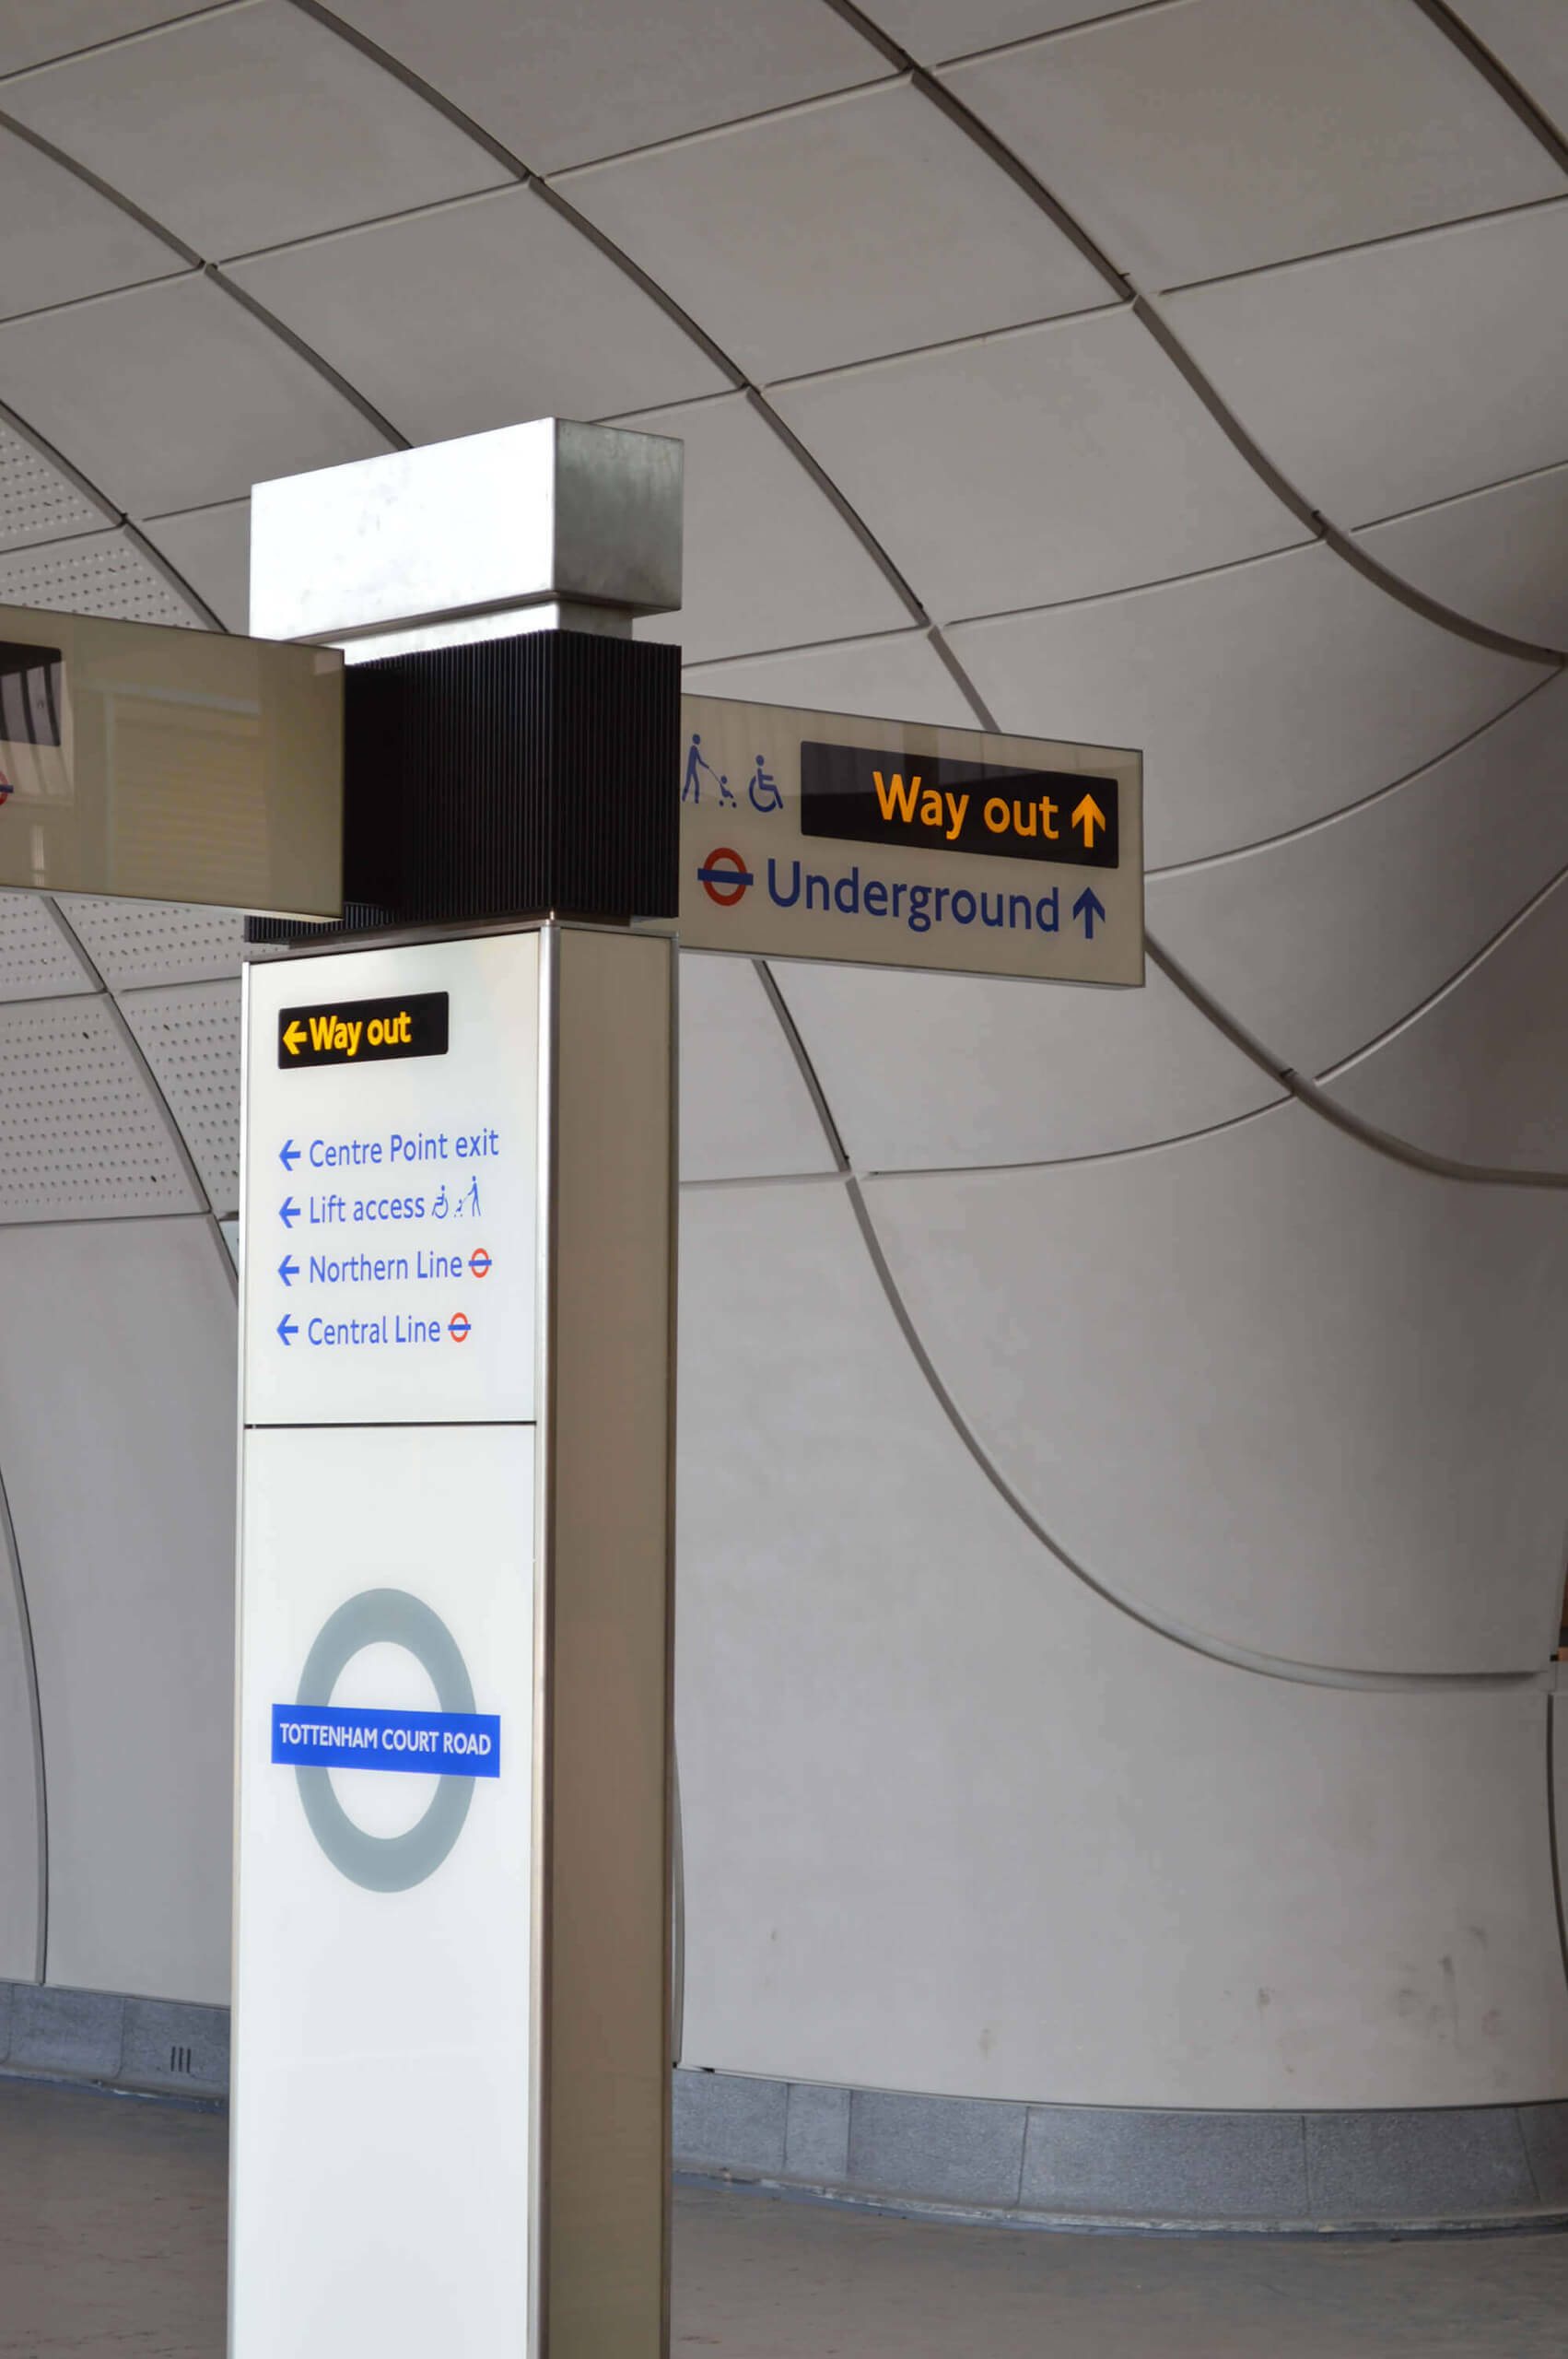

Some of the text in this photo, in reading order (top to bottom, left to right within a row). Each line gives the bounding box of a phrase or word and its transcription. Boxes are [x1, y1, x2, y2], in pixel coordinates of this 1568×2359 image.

[873, 770, 1059, 840] Way out
[767, 858, 1059, 933] Underground
[309, 1011, 412, 1056] Way out
[309, 1128, 499, 1168] Centre Point exit
[309, 1194, 425, 1224] Lift access
[309, 1250, 462, 1284] Northern Line
[307, 1314, 441, 1345] Central Line
[279, 1722, 492, 1756] TOTTENHAM COURT ROAD
